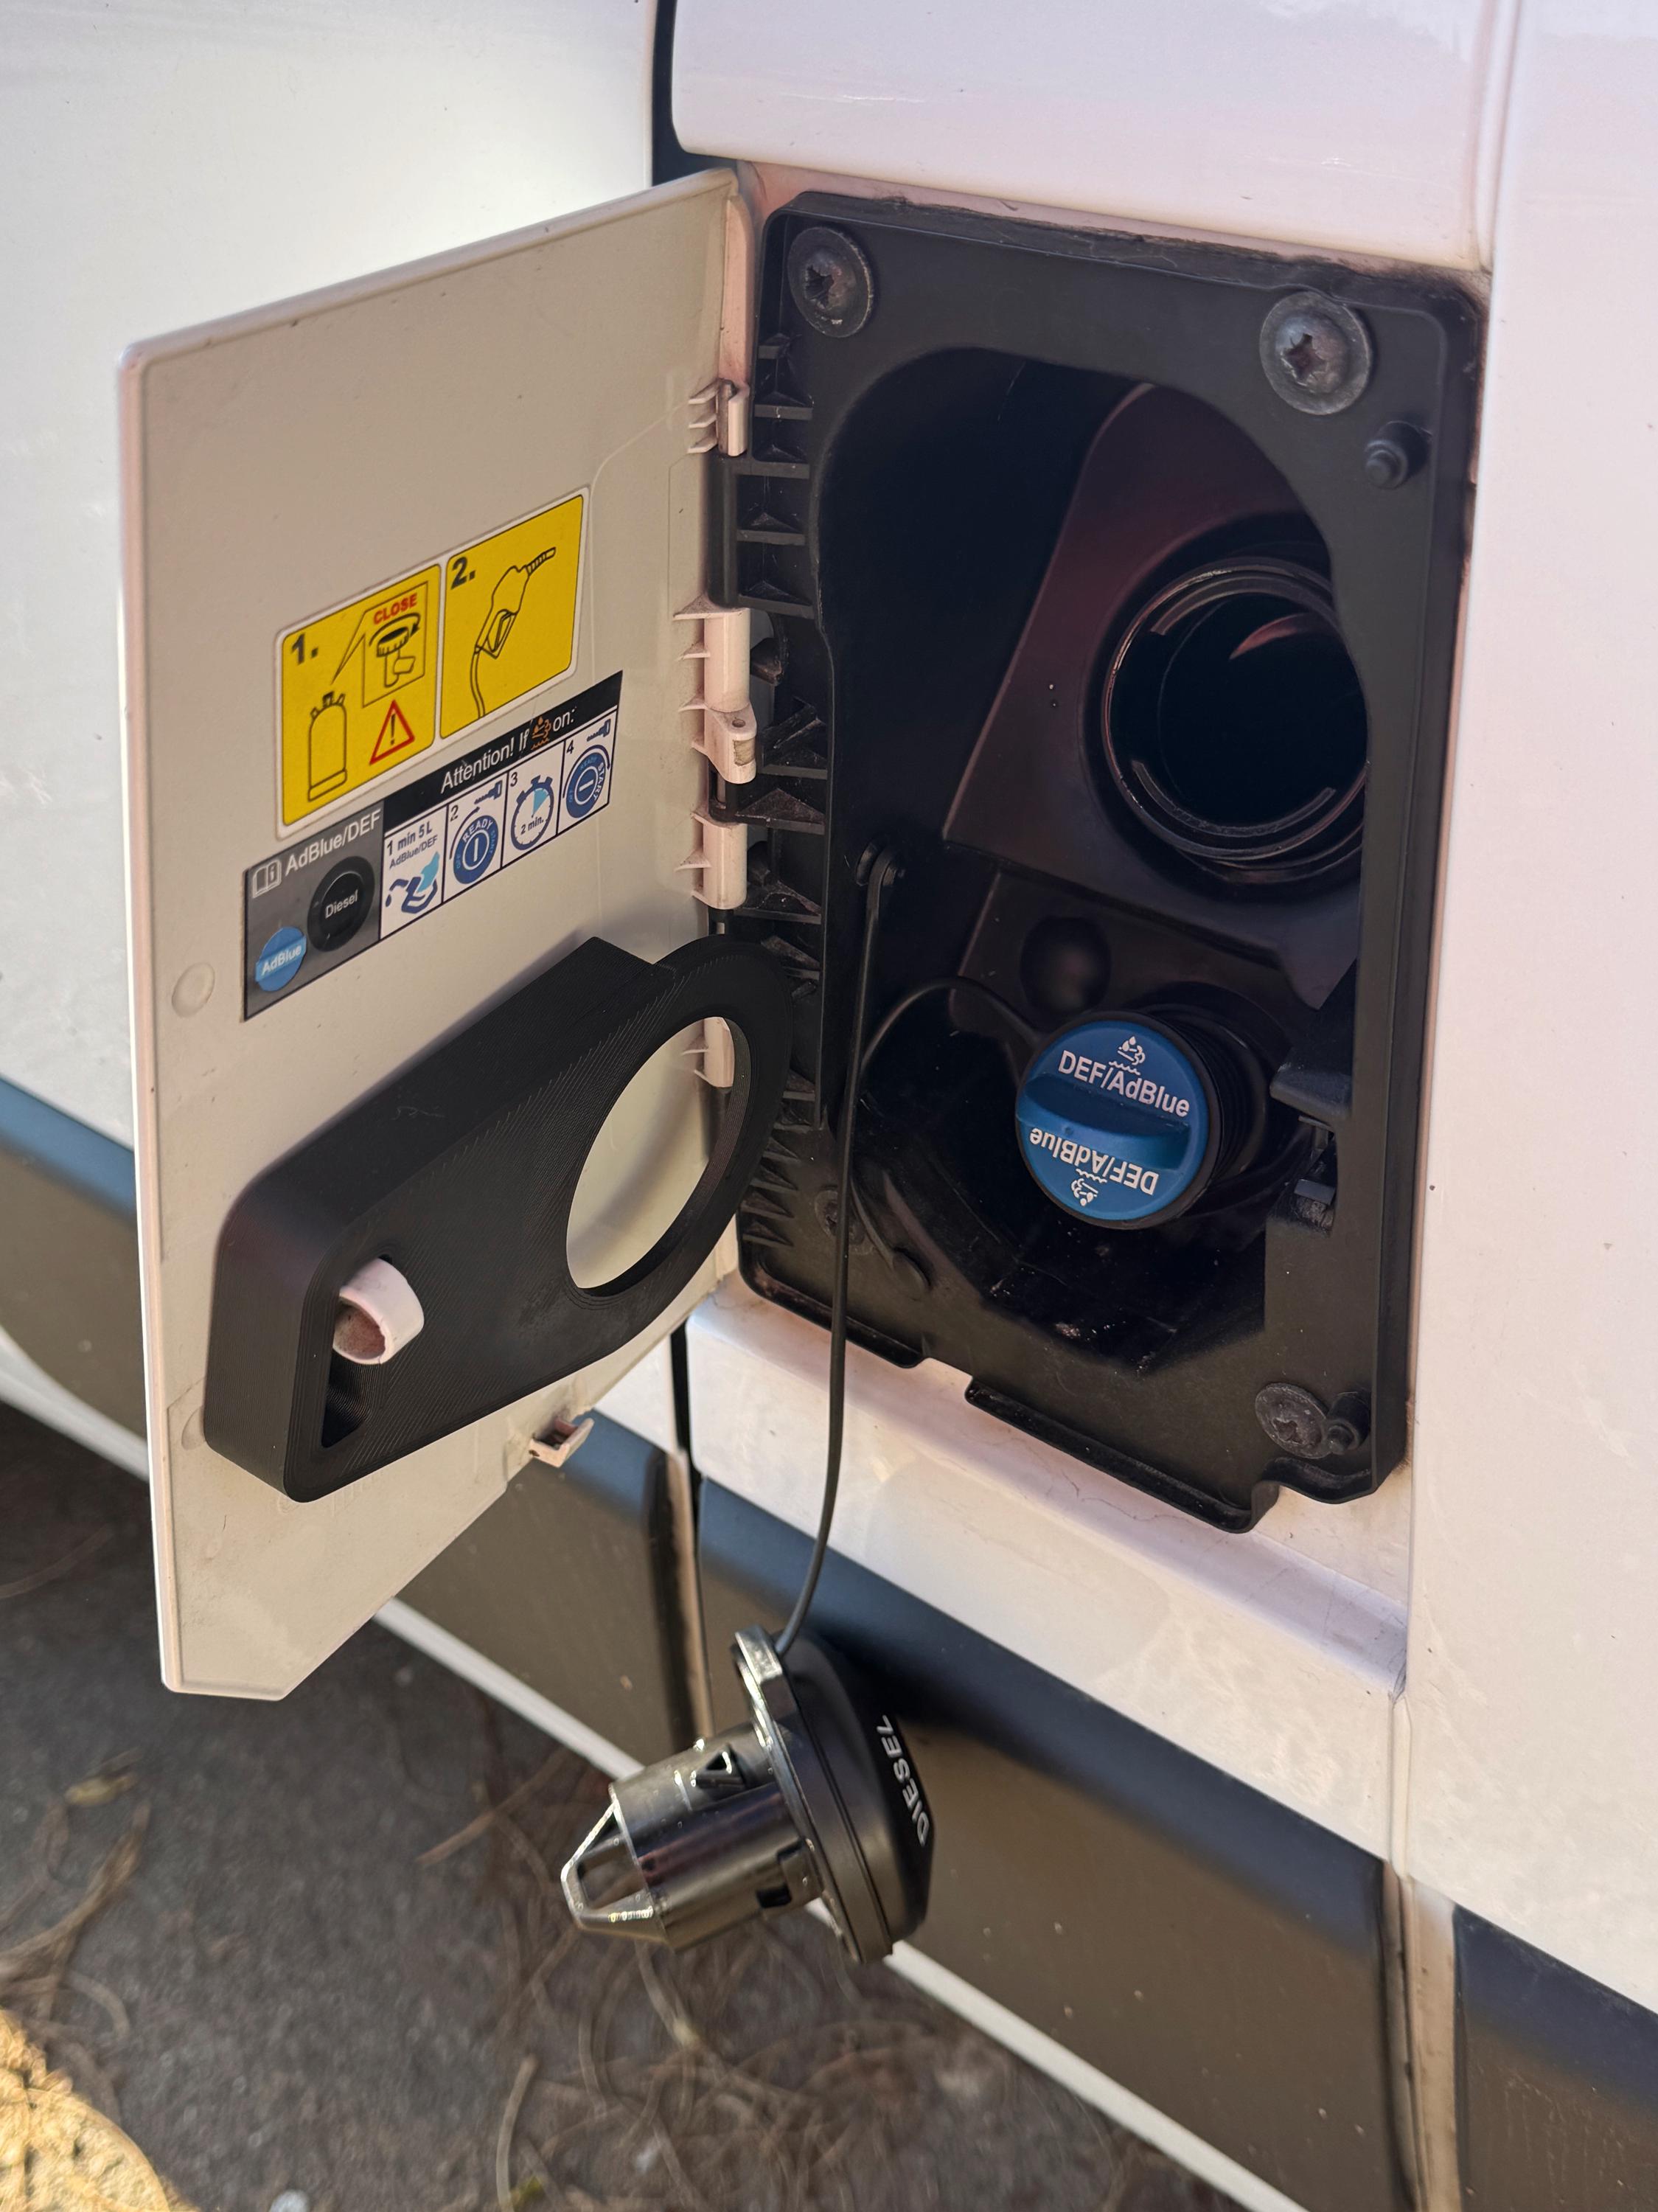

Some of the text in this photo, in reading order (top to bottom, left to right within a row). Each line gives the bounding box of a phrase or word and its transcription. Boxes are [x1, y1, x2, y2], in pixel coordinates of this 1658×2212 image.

[450, 557, 476, 590] 2.
[374, 593, 418, 625] CLOSE
[291, 633, 318, 665] 1.
[441, 709, 576, 794] Attention! If on:
[566, 740, 574, 754] 4
[509, 772, 518, 787] 3
[450, 804, 459, 822] 2
[520, 816, 544, 835] 2 min.
[285, 809, 381, 877] AdBlue/DEF
[397, 832, 416, 851] min
[462, 818, 493, 843] READY
[387, 840, 393, 856] 1
[389, 834, 438, 869] AdBlue/DEF
[325, 889, 358, 919] Diesel
[261, 944, 302, 976] AdBlue
[1058, 1050, 1190, 1117] DEF/AdBlue
[1029, 1127, 1160, 1196] DEF/AdBlue
[877, 1714, 930, 1846] DIESEL
